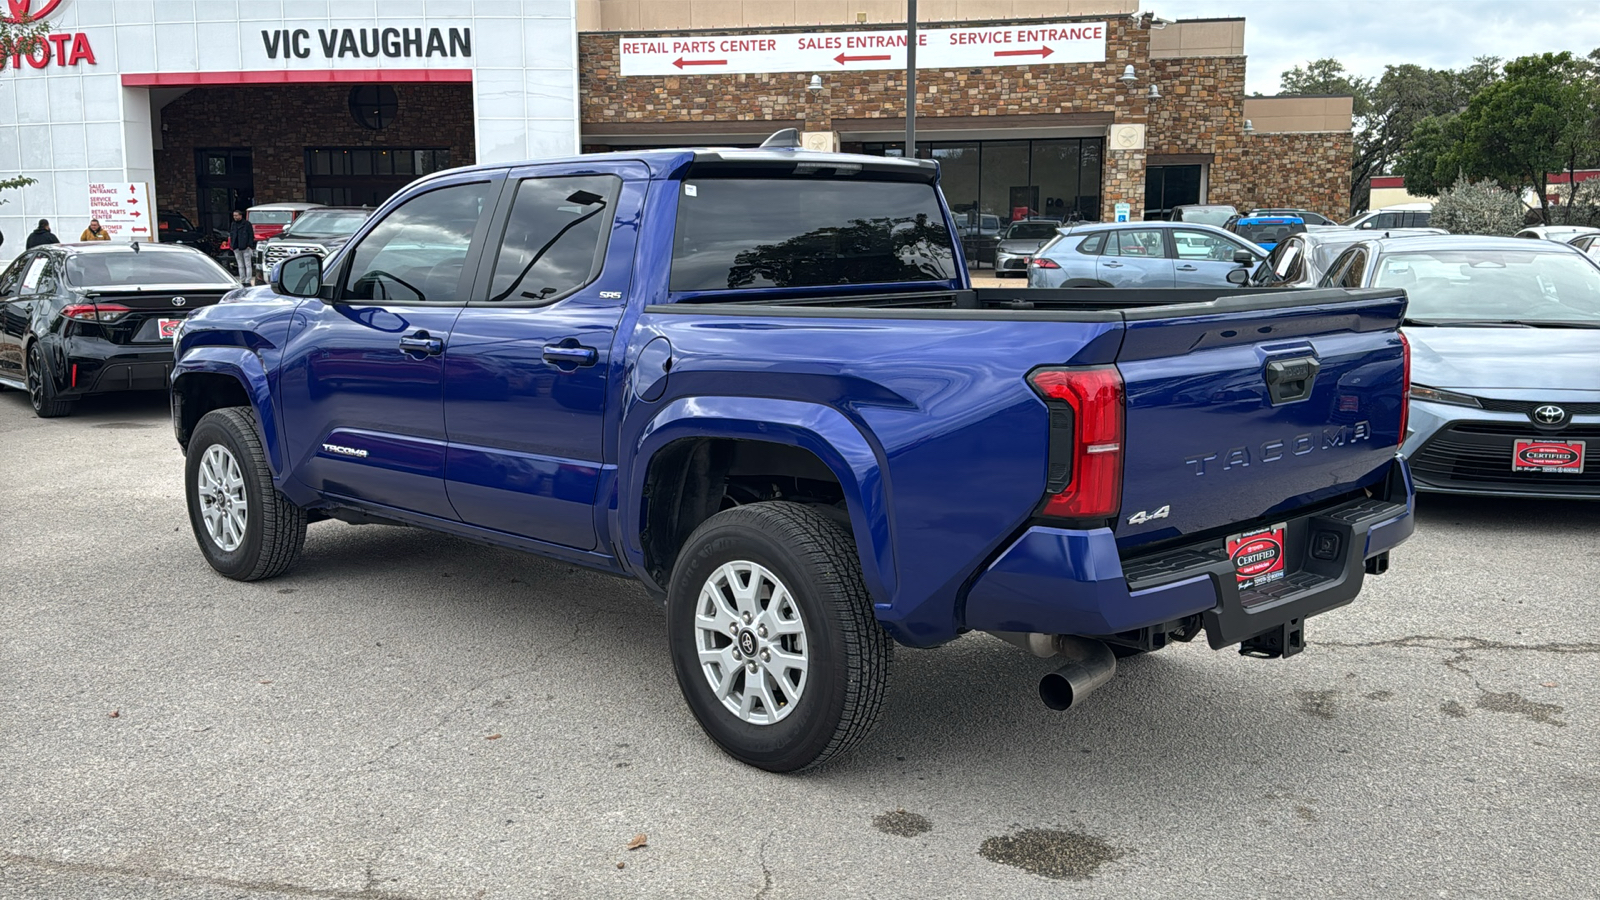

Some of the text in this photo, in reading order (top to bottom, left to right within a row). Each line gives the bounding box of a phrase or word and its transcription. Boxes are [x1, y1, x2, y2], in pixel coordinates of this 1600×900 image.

[261, 27, 473, 59] VIC VAUGHAN
[798, 34, 927, 50] SALES ENTRANE
[950, 27, 1102, 45] SERVICE ENTRANCE
[0, 32, 97, 70] YOTA
[622, 39, 777, 54] RETAIL PARTS CENTER
[322, 443, 368, 458] TACOMA
[1184, 420, 1372, 476] TACOMA
[1128, 505, 1170, 525] 4x4
[1237, 549, 1275, 566] CERTIFIED
